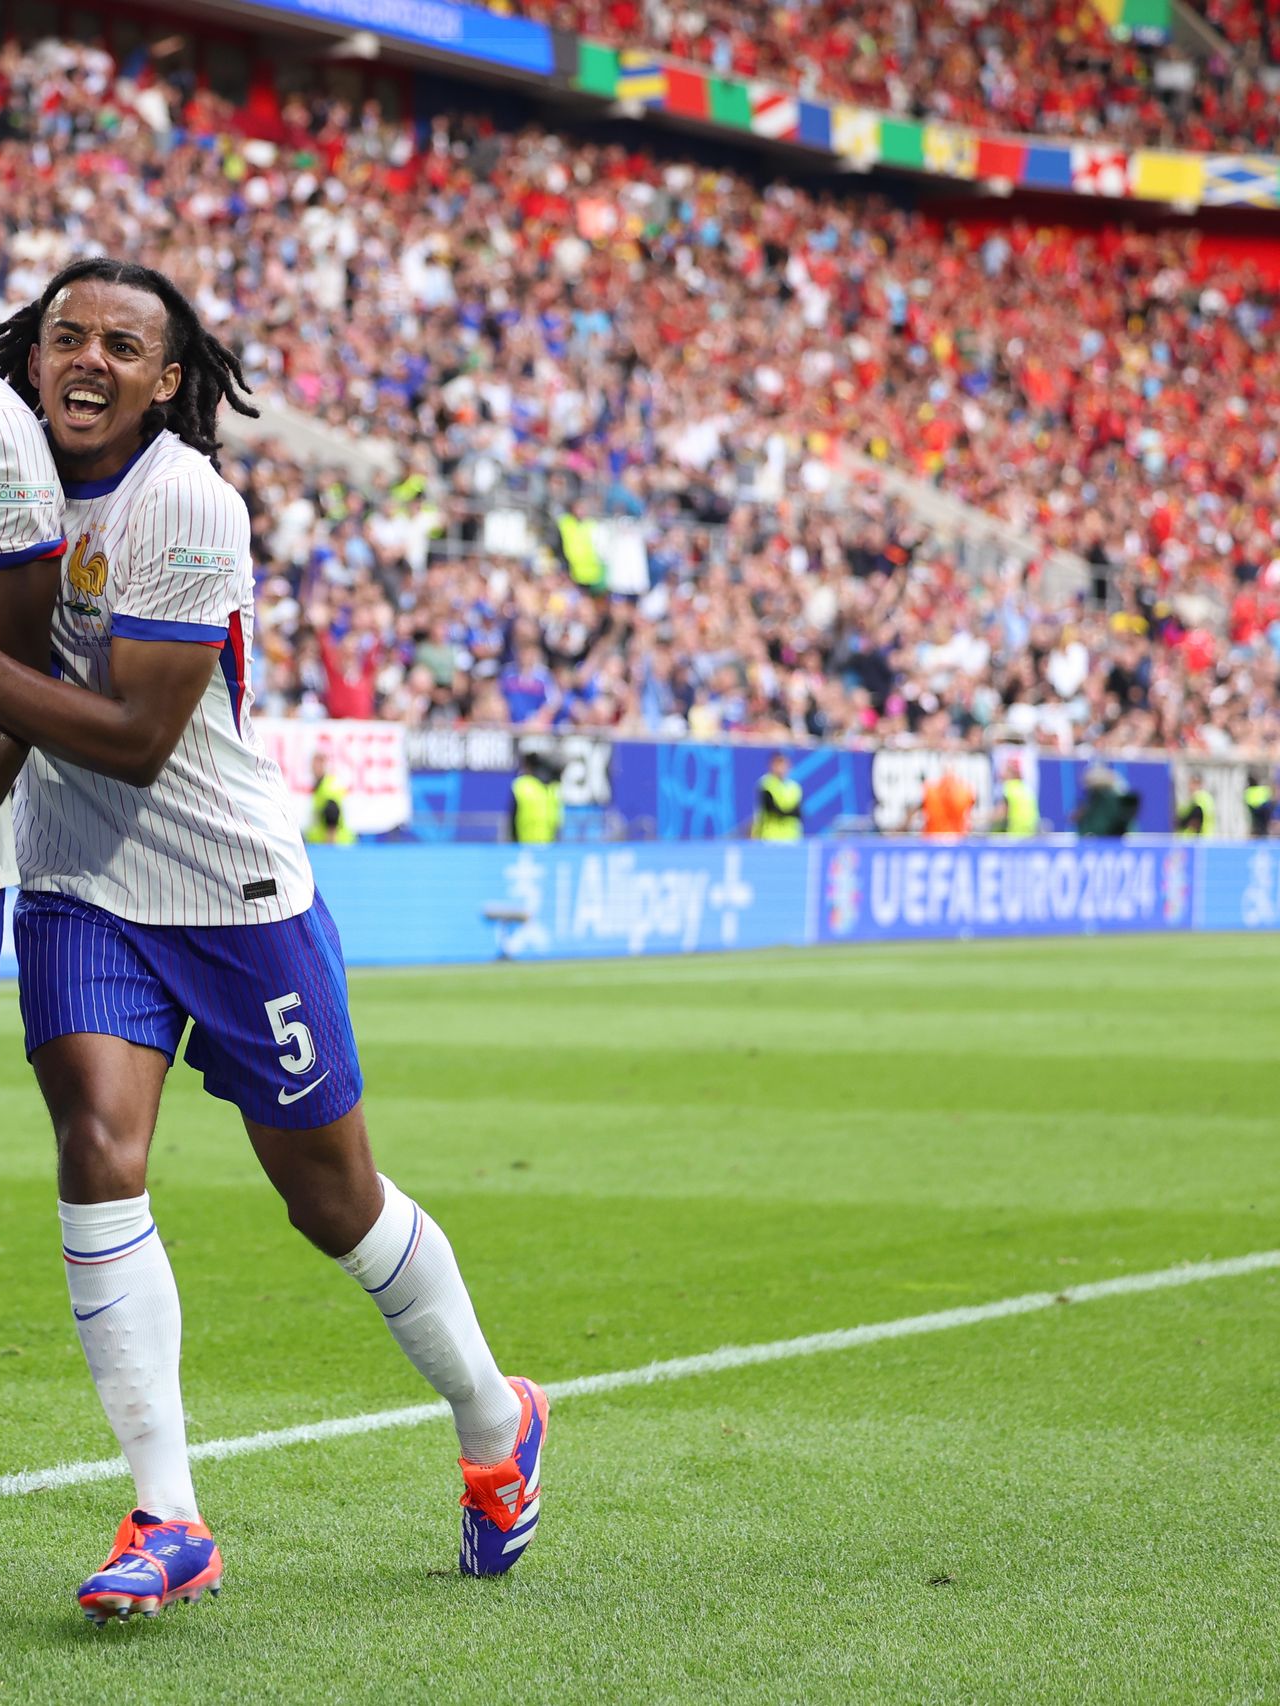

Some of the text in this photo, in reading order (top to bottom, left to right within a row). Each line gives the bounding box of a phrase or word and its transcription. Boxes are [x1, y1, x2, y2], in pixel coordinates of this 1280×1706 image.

[168, 554, 236, 566] FOUNDATION
[871, 848, 1156, 927] UEFA EURO 2024
[264, 991, 316, 1075] 5
